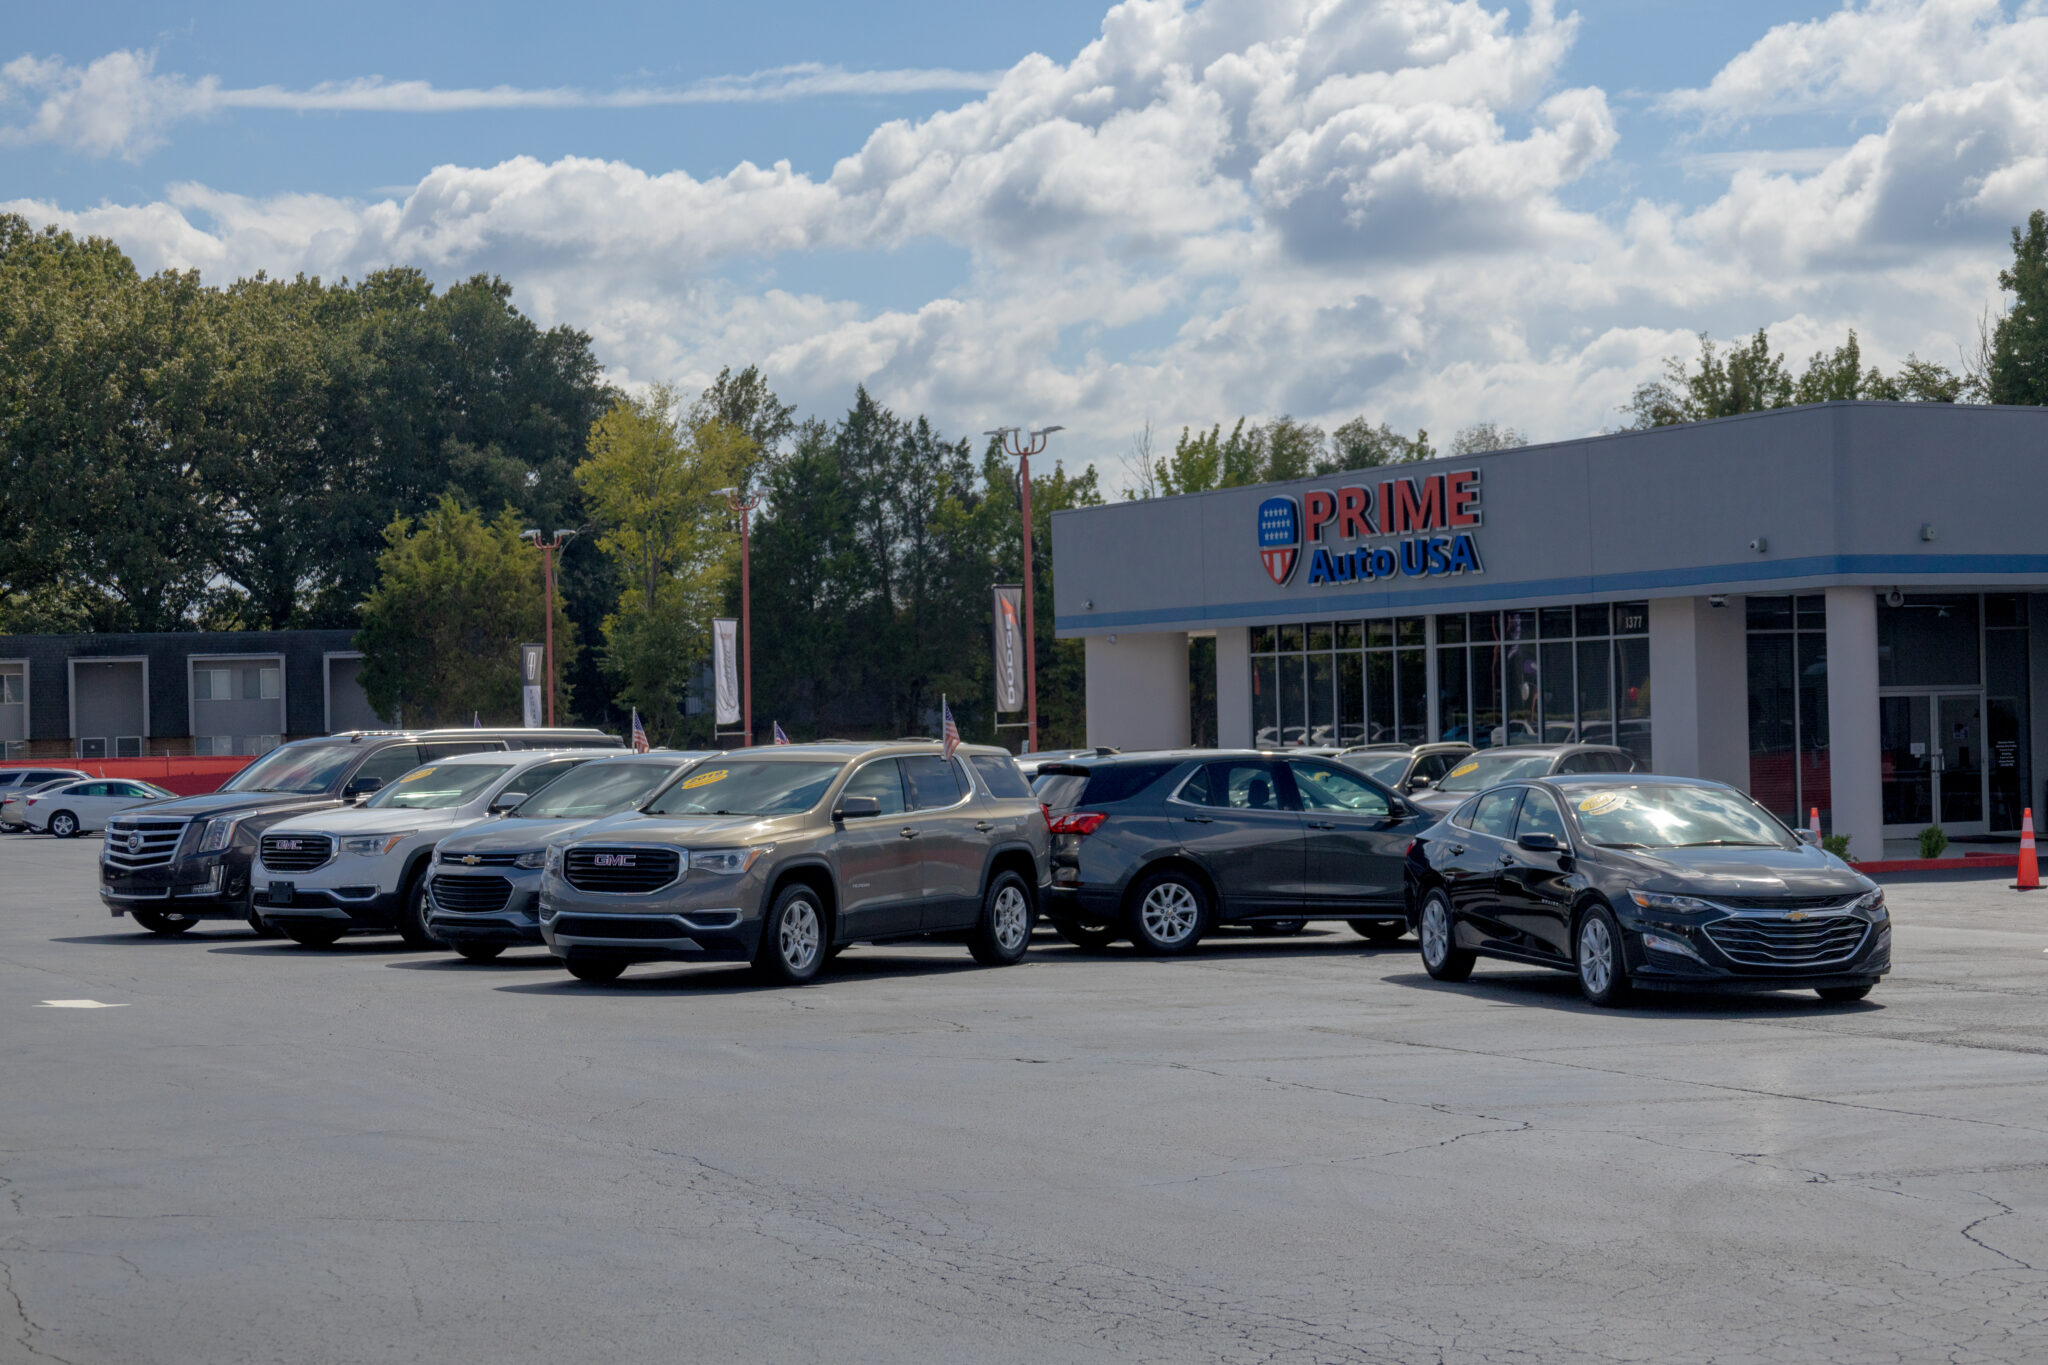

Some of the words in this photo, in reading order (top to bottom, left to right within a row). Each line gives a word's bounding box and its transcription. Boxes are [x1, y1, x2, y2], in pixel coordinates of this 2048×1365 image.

[1304, 468, 1482, 544] PRIME
[1308, 545, 1397, 586] Auto
[1400, 532, 1483, 579] USA
[1006, 613, 1016, 704] DODGE
[276, 840, 303, 850] GMC
[594, 853, 637, 867] GMC
